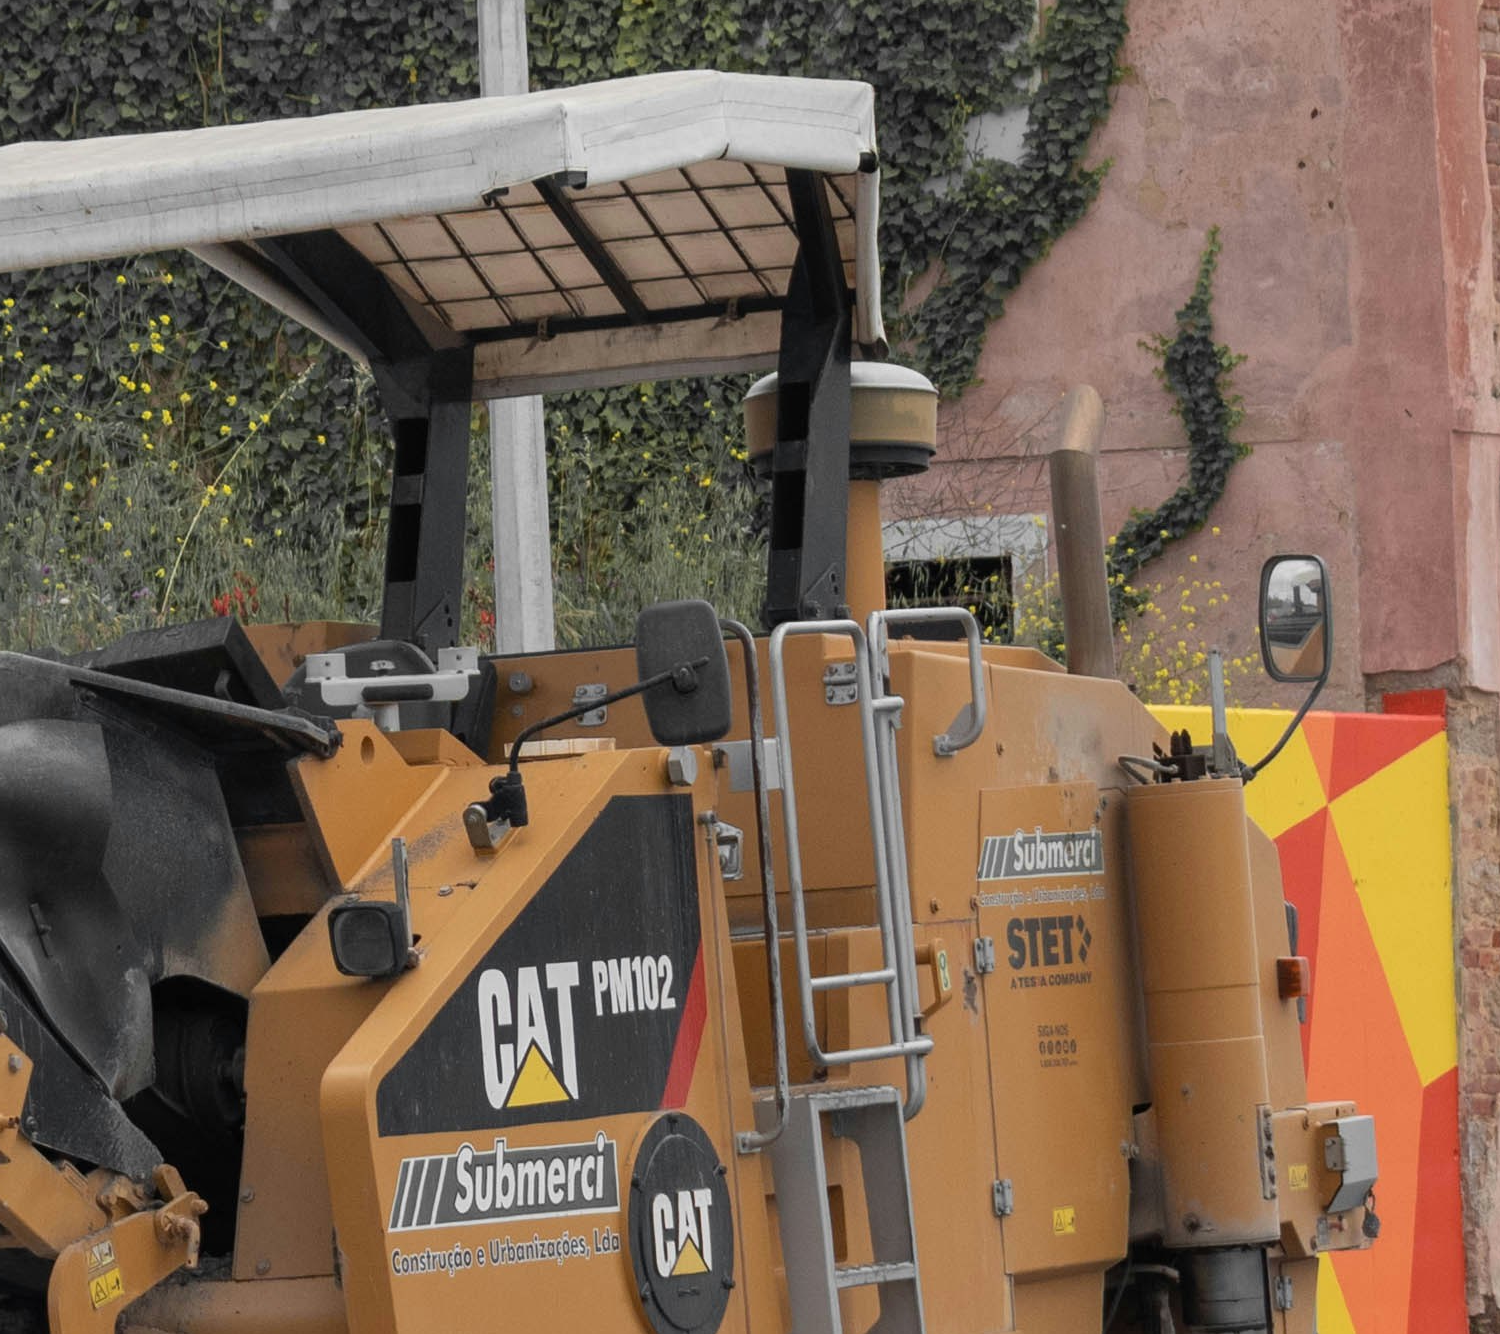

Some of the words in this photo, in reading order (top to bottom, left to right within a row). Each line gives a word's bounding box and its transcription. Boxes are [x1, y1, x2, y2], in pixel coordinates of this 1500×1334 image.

[1013, 826, 1096, 871] Submerci
[1007, 915, 1074, 970] STET
[1018, 975, 1048, 988] TESA
[1049, 971, 1093, 986] COMPANY
[477, 961, 580, 1110] CAT
[592, 954, 677, 1016] PM102
[454, 1133, 605, 1214] Submerci
[392, 1243, 472, 1276] Construção
[476, 1247, 485, 1265] e
[489, 1230, 590, 1265] Urbanizações,
[593, 1226, 621, 1253] Lda
[652, 1187, 713, 1278] CAT
